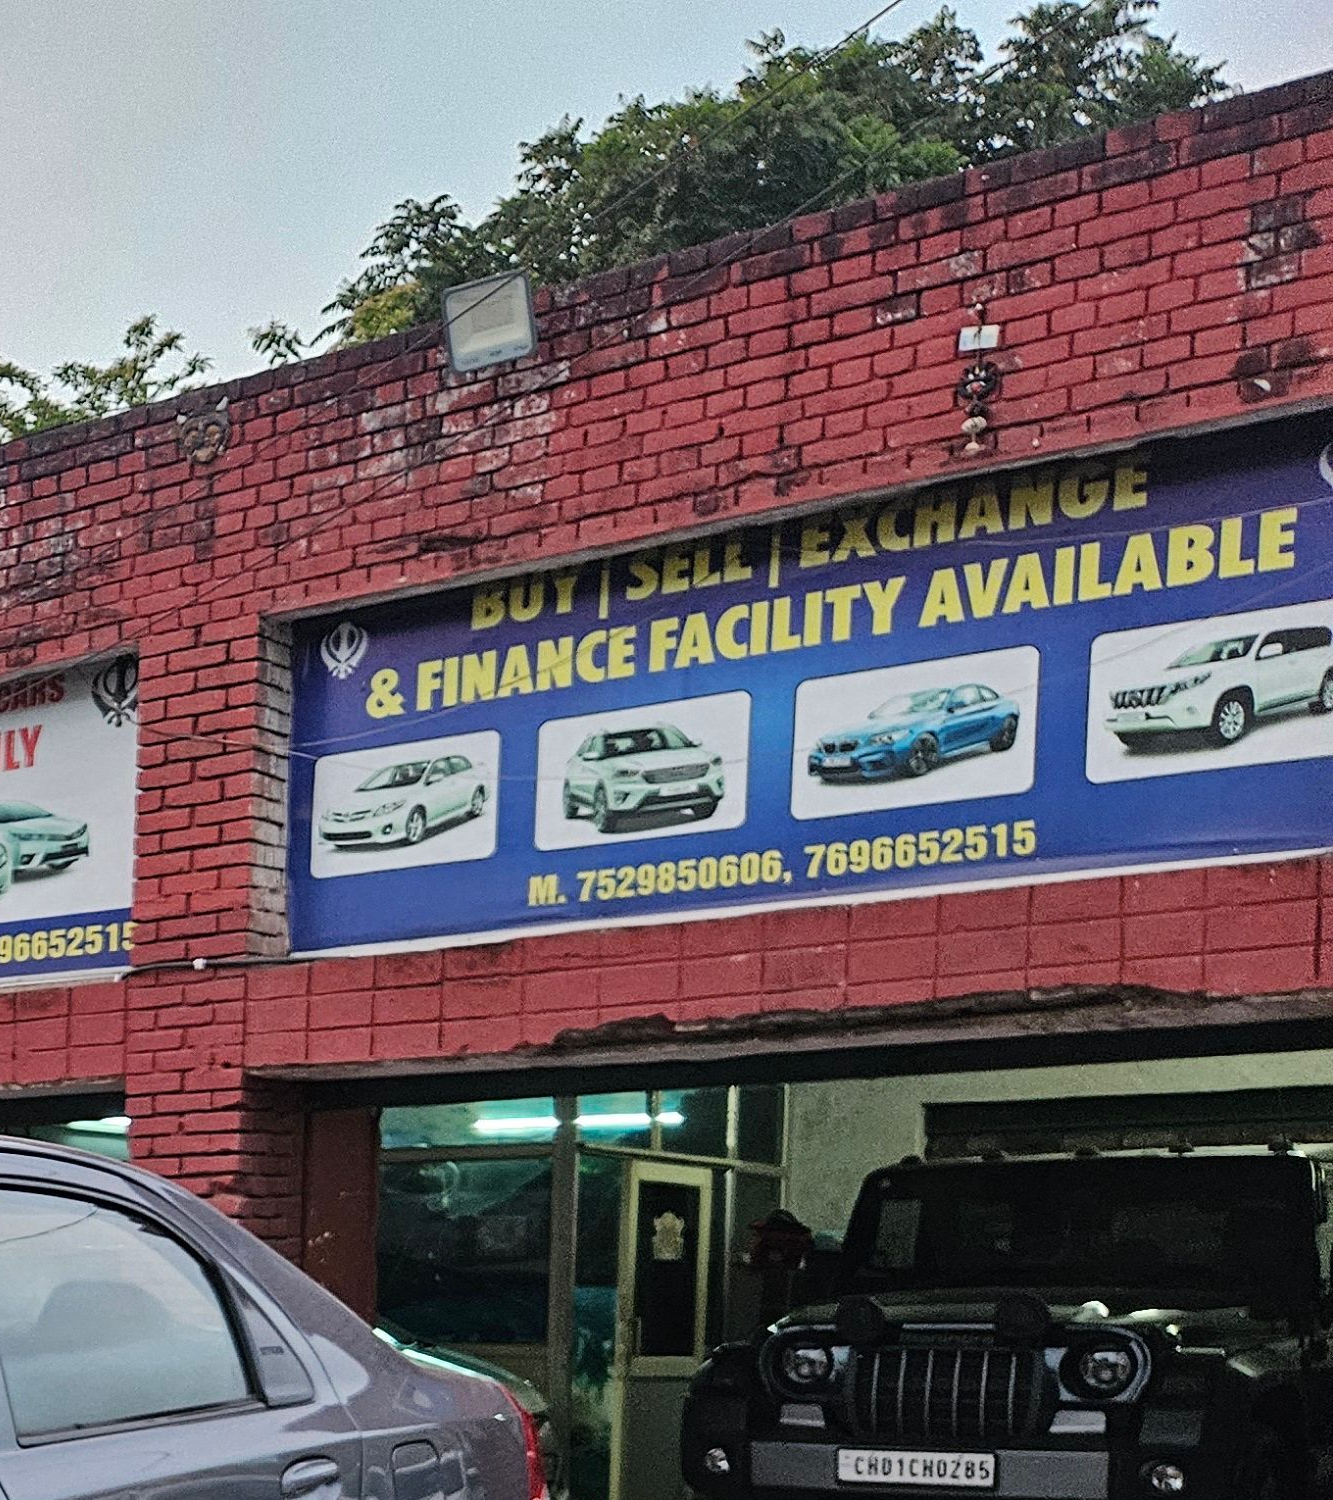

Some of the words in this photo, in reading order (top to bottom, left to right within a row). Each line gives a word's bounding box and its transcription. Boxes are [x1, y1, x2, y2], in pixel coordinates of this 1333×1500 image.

[470, 567, 578, 631] BUY
[626, 540, 754, 601] SELL
[799, 464, 1148, 568] EXCHANGE
[365, 667, 406, 719] &
[415, 625, 636, 712] FINANCE
[648, 575, 907, 674] FACILITY
[917, 505, 1299, 628] AVAILABLE
[527, 875, 567, 906] M.
[576, 849, 793, 901] 7529850606,
[804, 820, 1037, 879] 7696652515
[854, 1456, 990, 1480] CH01CH0285
